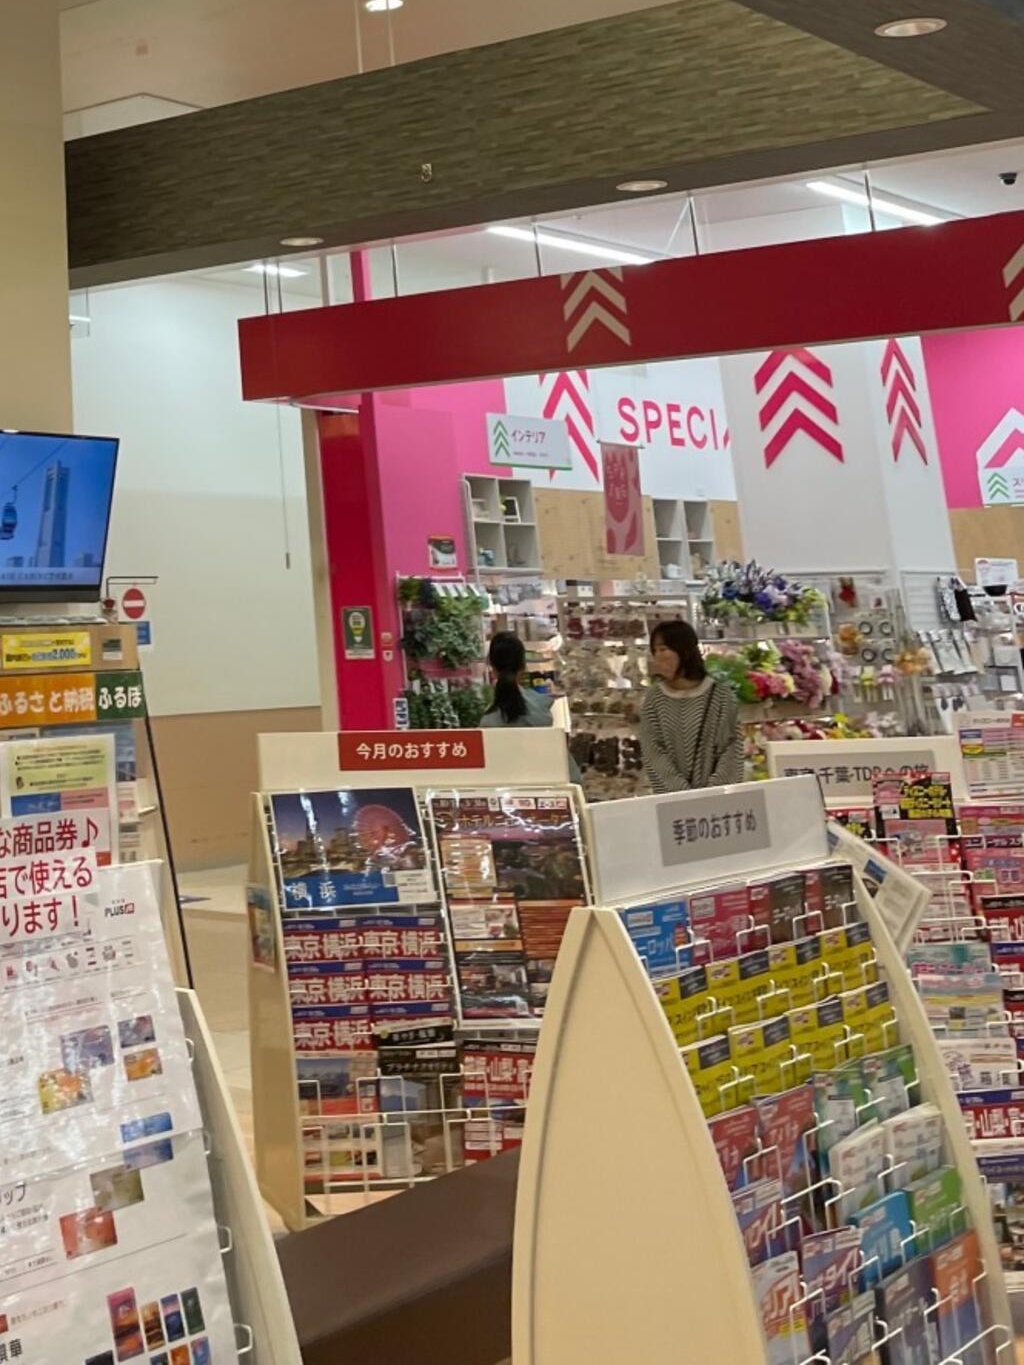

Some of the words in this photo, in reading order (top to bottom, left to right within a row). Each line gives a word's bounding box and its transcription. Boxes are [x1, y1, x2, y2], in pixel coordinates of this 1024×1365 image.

[618, 397, 730, 450] SPECI
[356, 742, 467, 760] 今月のおすすめ
[673, 809, 756, 846] 季節のおすすめ
